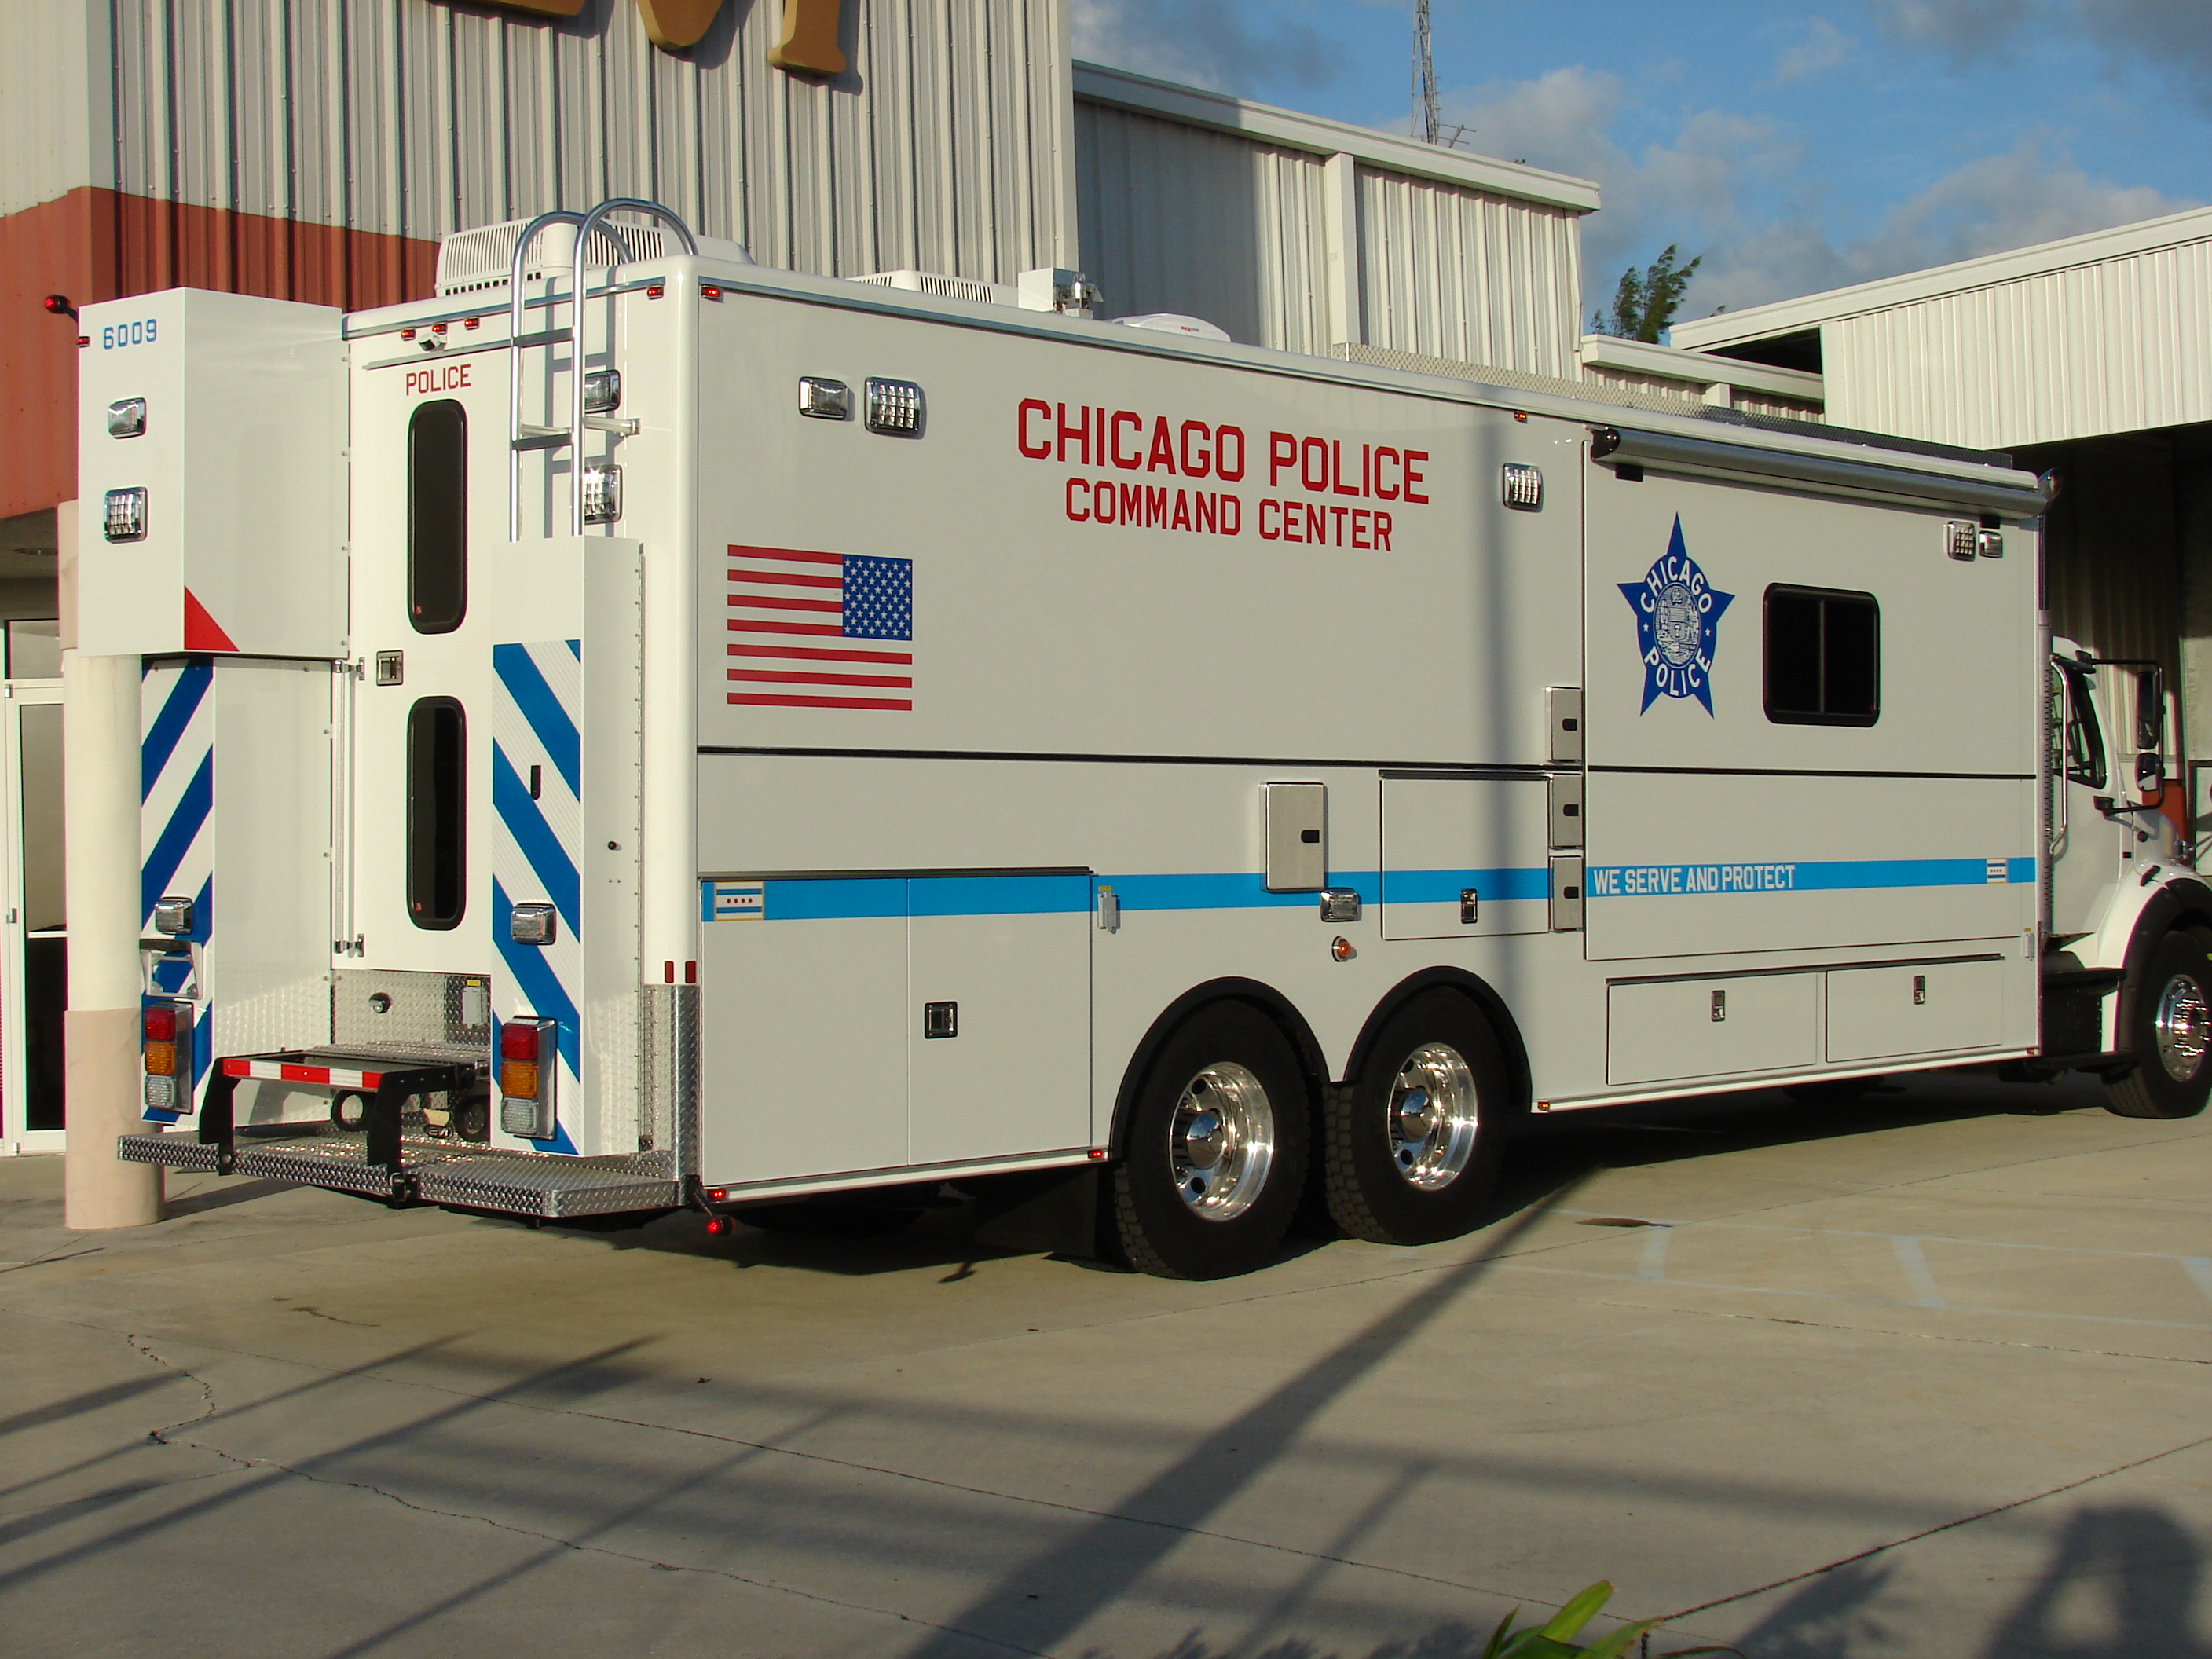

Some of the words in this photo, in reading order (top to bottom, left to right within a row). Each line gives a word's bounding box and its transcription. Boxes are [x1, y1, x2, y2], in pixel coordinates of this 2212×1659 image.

[103, 318, 157, 350] 6009
[405, 364, 472, 396] POLICE
[1018, 398, 1245, 482] CHICAGO
[1269, 431, 1430, 505] POLICE
[1065, 478, 1241, 536] COMMAND
[1258, 498, 1393, 551] CENTER
[1640, 556, 1712, 613] CHICAGO
[1644, 646, 1712, 696] POLICE
[1593, 869, 1621, 895] WE
[1624, 866, 1683, 894] SERVE
[1686, 866, 1719, 892] AND
[1721, 864, 1796, 891] PROTECT
